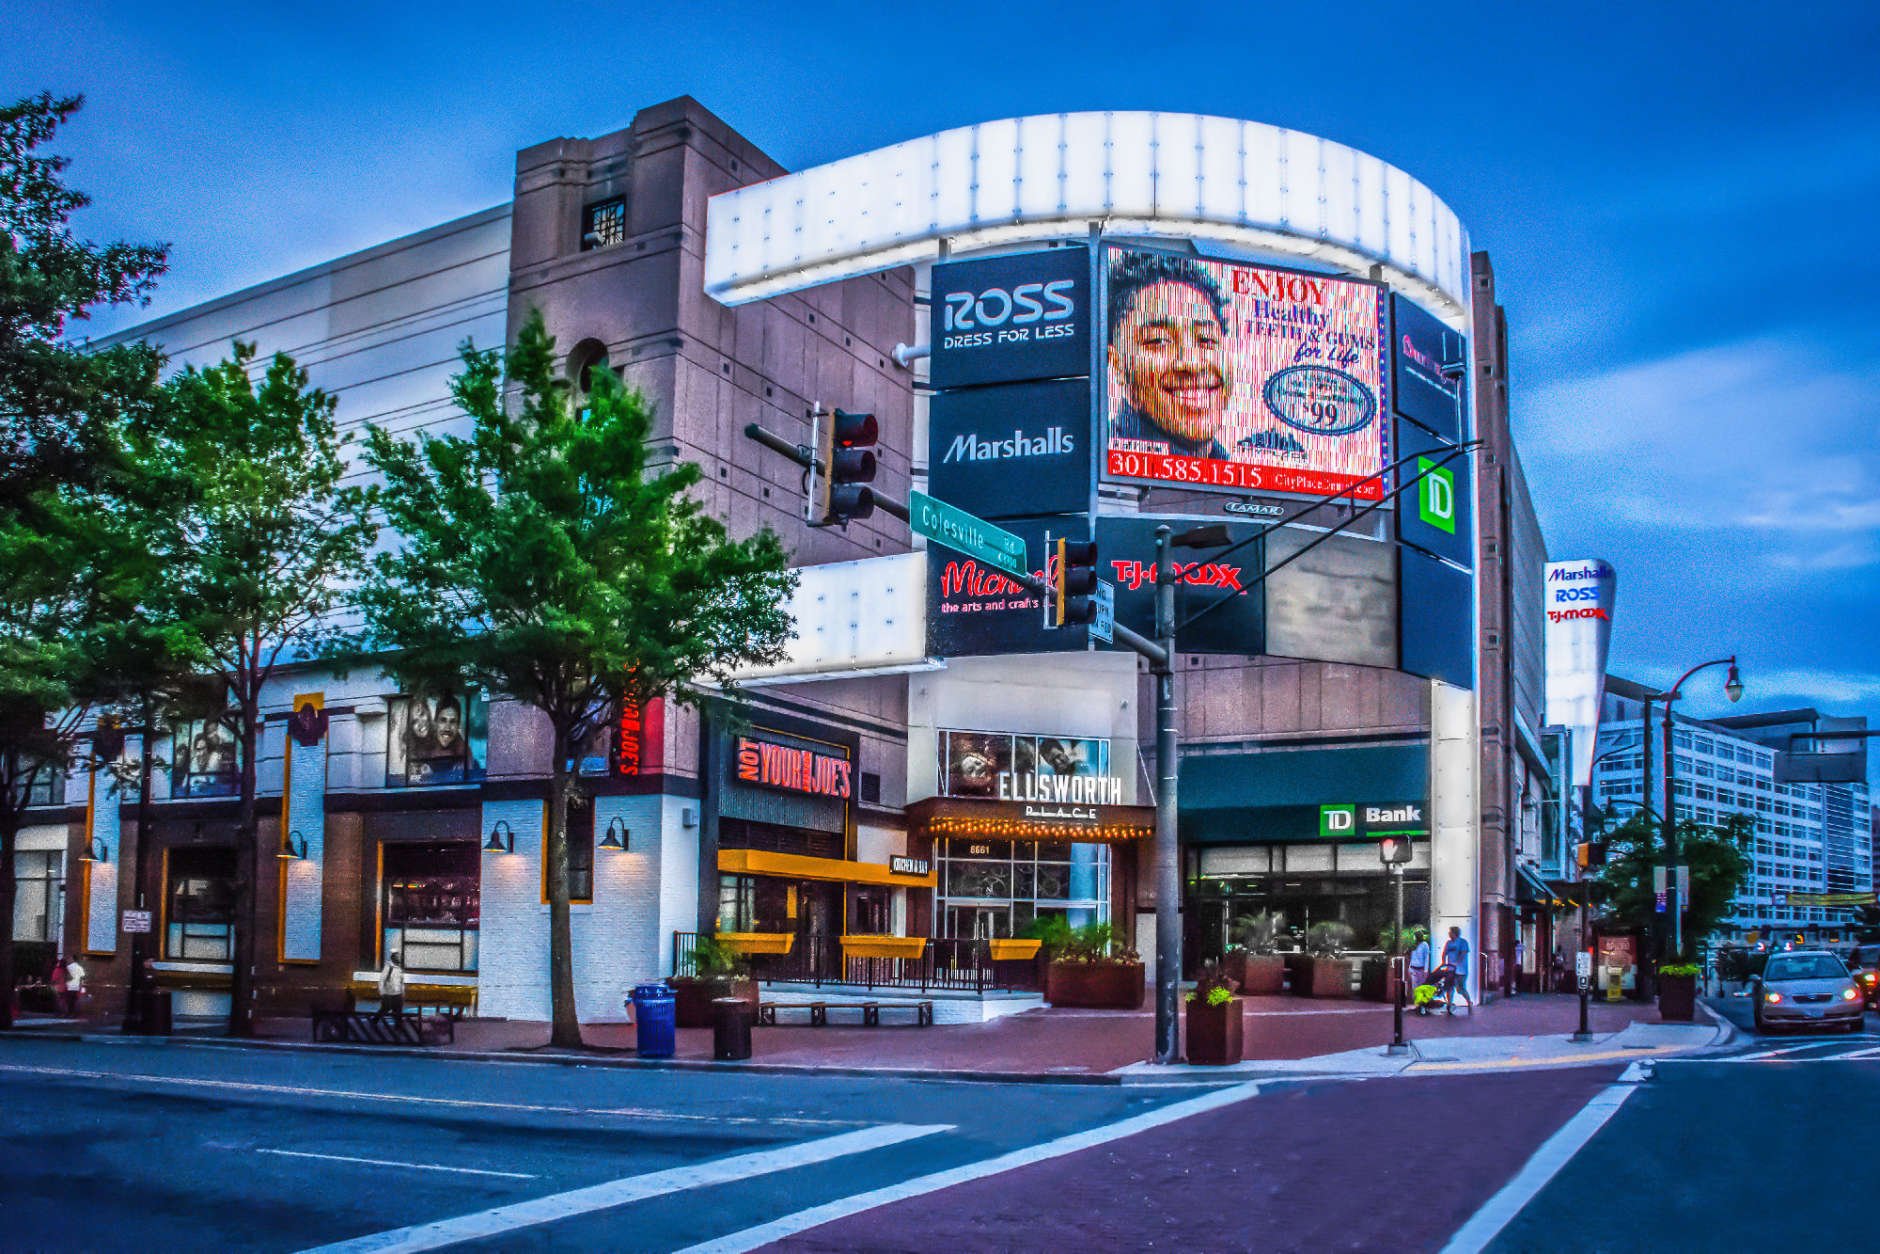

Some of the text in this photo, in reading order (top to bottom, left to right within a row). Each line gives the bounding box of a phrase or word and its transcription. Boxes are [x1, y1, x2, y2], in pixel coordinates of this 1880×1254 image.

[1232, 269, 1326, 306] ENJOY
[944, 280, 1075, 332] ROSS
[1254, 299, 1329, 330] Healthy
[944, 323, 1075, 350] DRESS FOR LESS
[1293, 340, 1322, 363] for
[943, 427, 1075, 464] Marshalls
[1111, 452, 1263, 488] 301.585.1515
[1231, 502, 1279, 516] LAMAR
[1421, 466, 1452, 520] TD
[922, 505, 985, 550] Colesville
[942, 601, 958, 613] the
[962, 600, 982, 612] arts
[985, 599, 1005, 611] and
[1008, 597, 1039, 610] crafts
[1555, 585, 1601, 602] ROSS
[739, 737, 759, 781] NOT
[760, 742, 801, 790] YOUR
[1000, 770, 1121, 806] ELLSWORTH
[1025, 805, 1097, 819] PLACE
[1323, 805, 1421, 830] TD Bank
